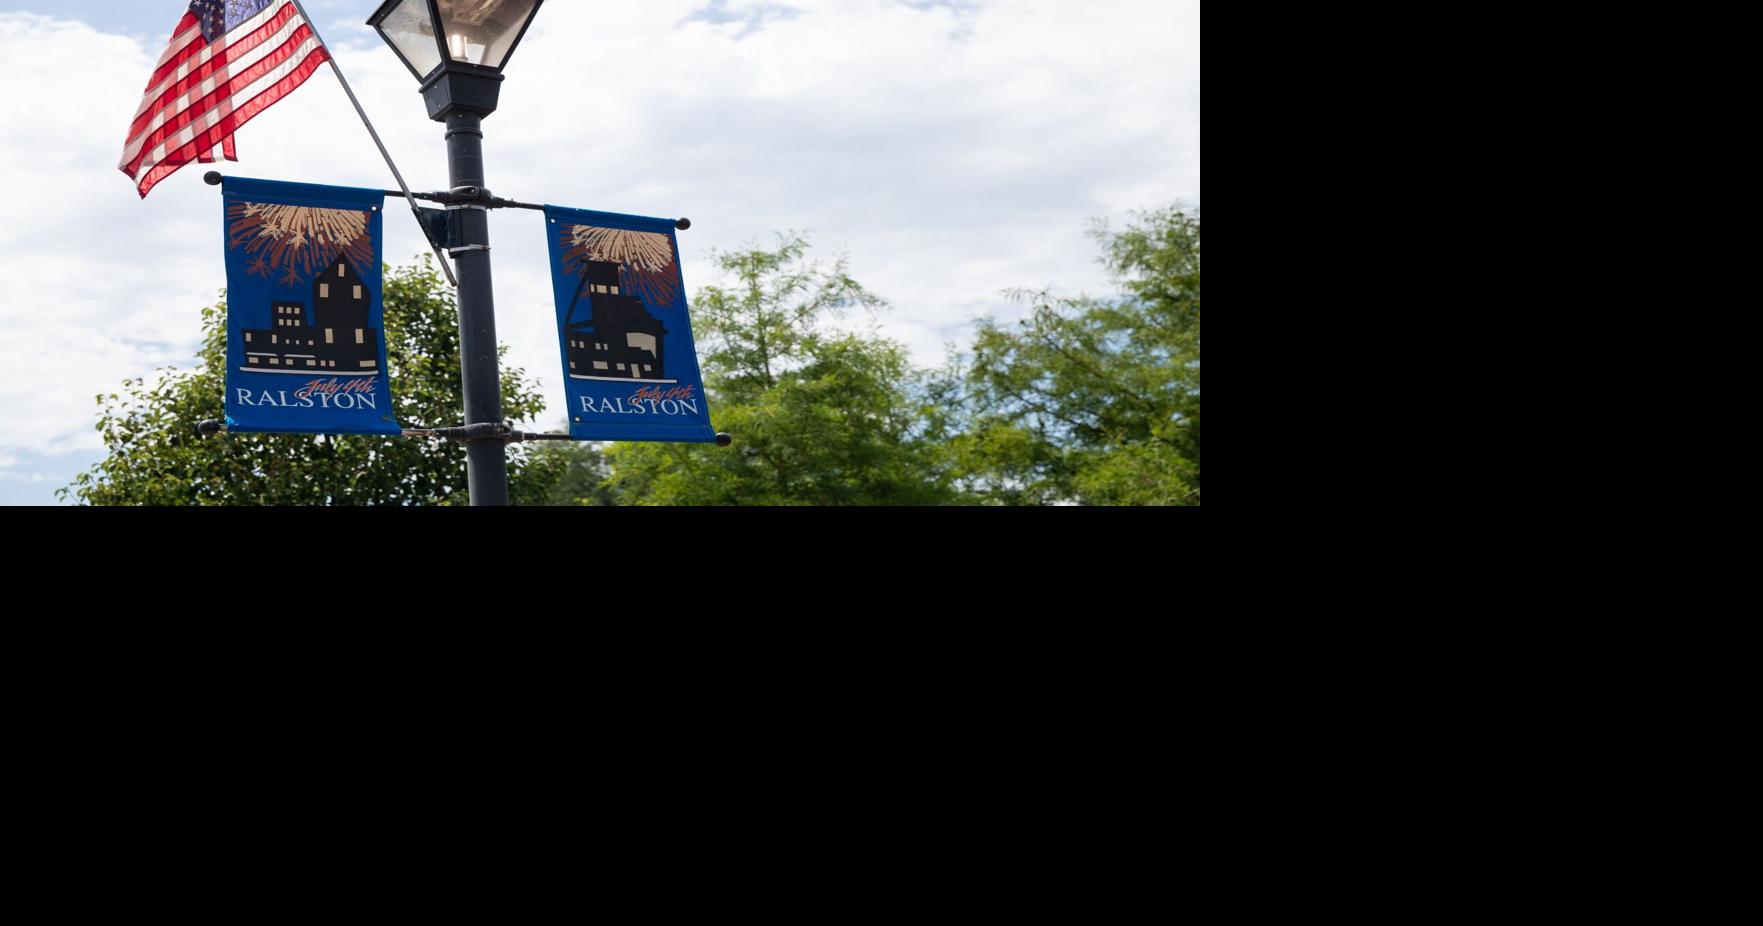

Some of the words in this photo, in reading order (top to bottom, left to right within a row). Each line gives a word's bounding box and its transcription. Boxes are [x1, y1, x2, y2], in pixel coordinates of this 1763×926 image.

[236, 388, 377, 410] RALSTON
[294, 377, 343, 402] July
[344, 376, 378, 396] 4th
[628, 384, 664, 406] July
[580, 396, 698, 415] RALSTON
